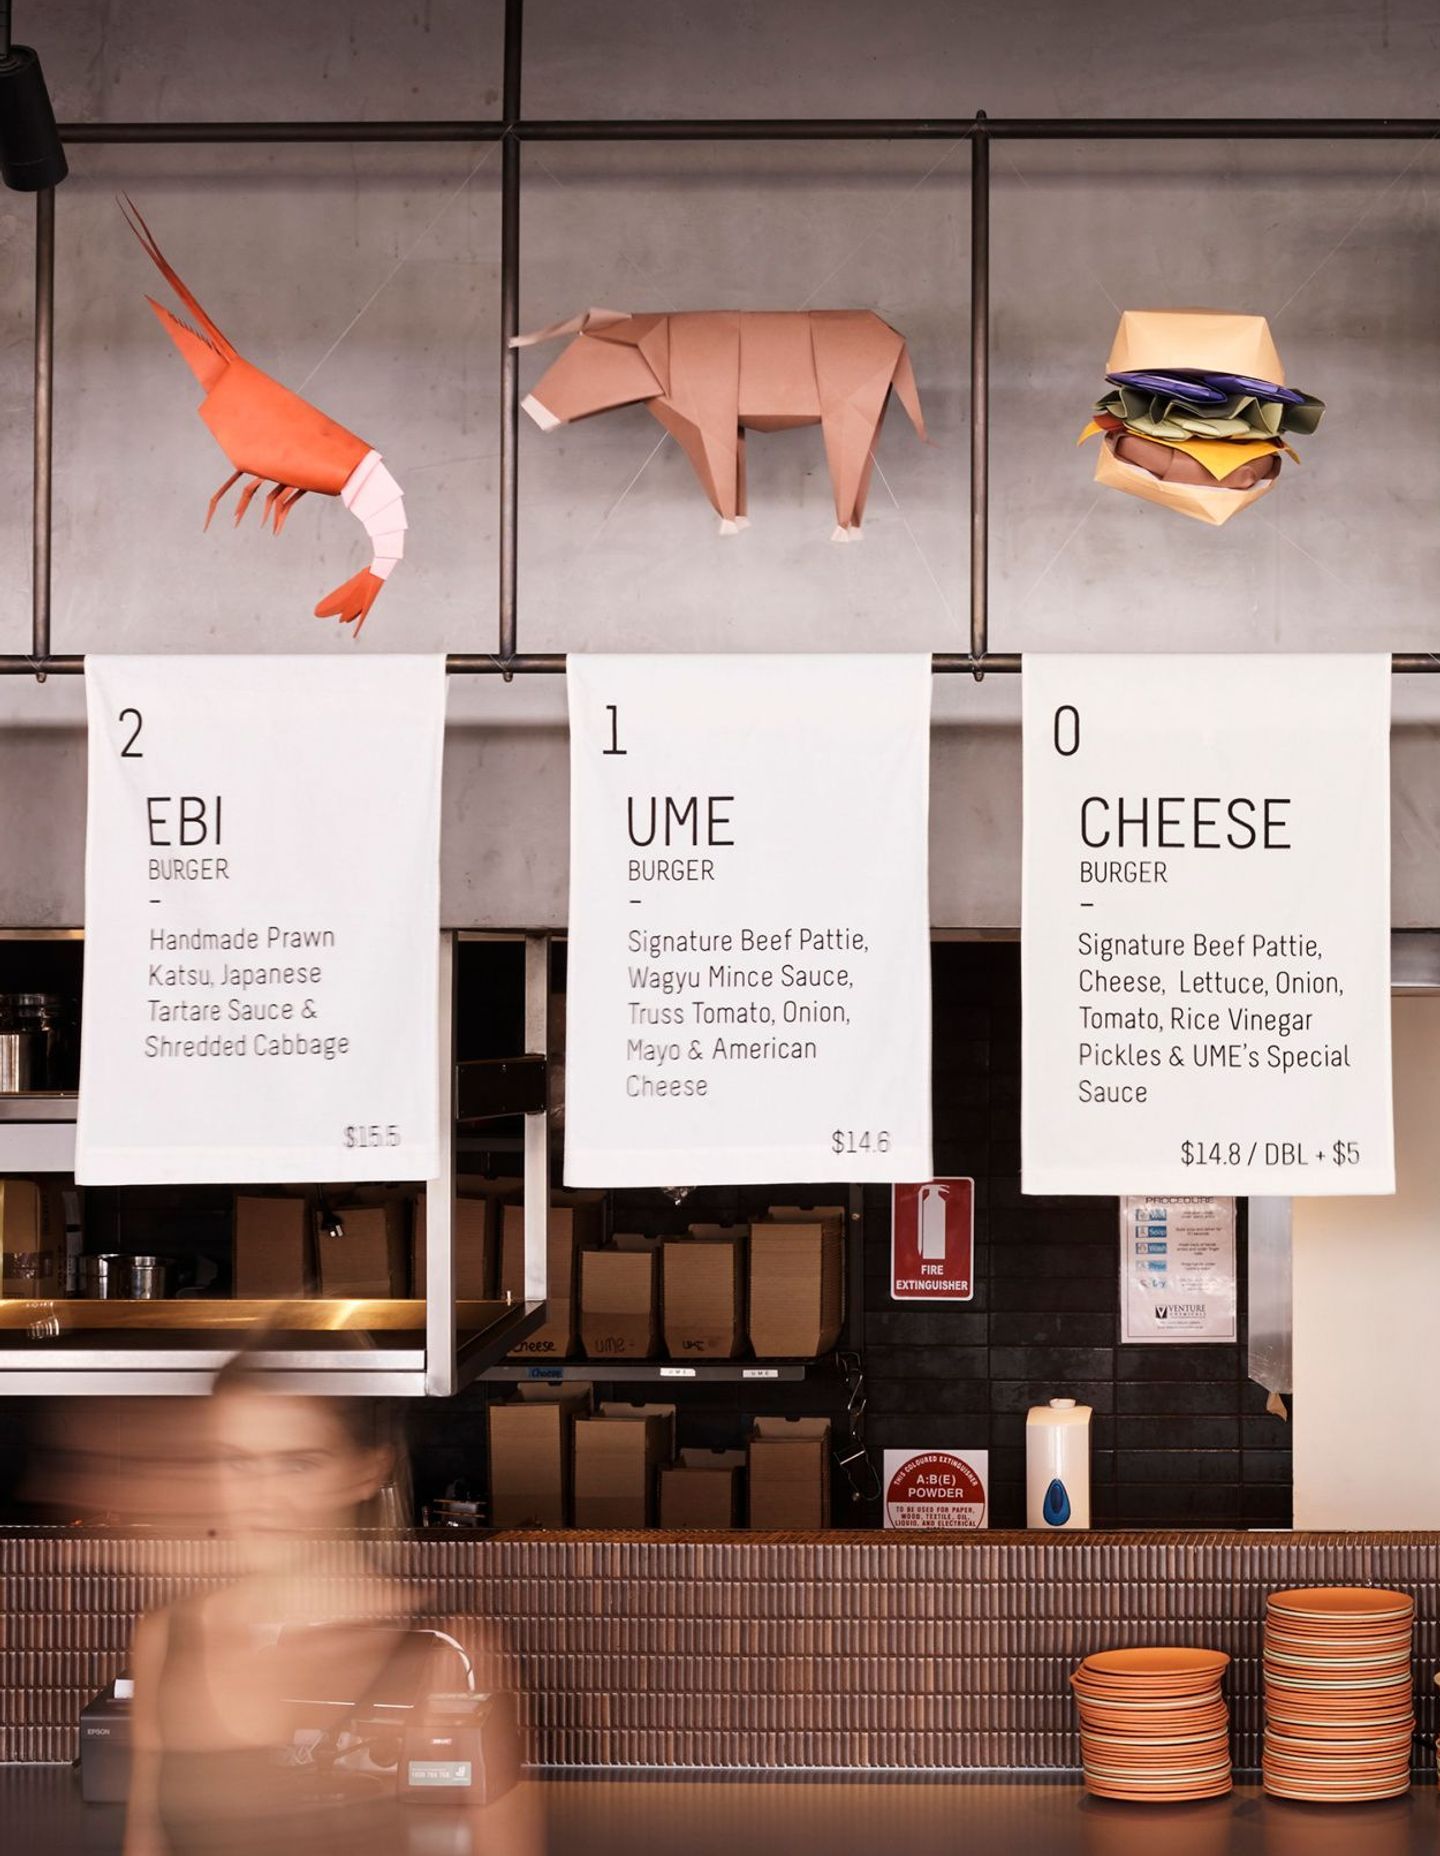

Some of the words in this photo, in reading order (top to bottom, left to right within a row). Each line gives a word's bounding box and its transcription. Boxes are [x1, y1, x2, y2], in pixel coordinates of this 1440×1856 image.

[119, 708, 143, 757] 2
[603, 705, 627, 754] 1
[147, 796, 221, 846] EBI
[628, 796, 734, 846] UME
[1081, 797, 1291, 849] CHEESE
[149, 858, 229, 880] BURGER
[629, 859, 714, 881] BURGER
[1081, 861, 1167, 883] BURGER
[151, 928, 258, 950] Handmade
[268, 927, 334, 948] Prawn
[629, 930, 732, 958] Signature
[742, 928, 792, 951] Beef
[800, 928, 868, 952] Pattie,
[1079, 933, 1184, 962] Signature
[1194, 934, 1245, 956] Beef
[1253, 934, 1321, 959] Pattie,
[149, 965, 214, 987] Katsu,
[221, 964, 321, 990] Japanese
[629, 966, 699, 994] Wagyu
[710, 966, 772, 987] Mince
[781, 964, 853, 988] Sauce,
[1080, 969, 1165, 995] Cheese,
[1181, 970, 1268, 997] Lettuce,
[1277, 971, 1343, 996] Onion,
[148, 1000, 220, 1022] Tartare
[228, 999, 293, 1021] Sauce
[301, 999, 317, 1019] &
[628, 1002, 684, 1024] Truss
[692, 1002, 775, 1025] Tomato,
[784, 1001, 850, 1025] Onion,
[1079, 1006, 1163, 1032] Tomato,
[1172, 1007, 1219, 1030] Rice
[1228, 1008, 1312, 1037] Vinegar
[145, 1035, 246, 1057] Shredded
[254, 1034, 348, 1060] Cabbage
[628, 1039, 680, 1067] Mayo
[688, 1040, 703, 1060] &
[712, 1037, 816, 1059] American
[1080, 1043, 1161, 1066] Pickles
[1169, 1046, 1184, 1066] &
[1268, 1045, 1350, 1074] Special
[627, 1075, 707, 1097] Cheese
[1079, 1080, 1147, 1103] Sauce
[832, 1129, 889, 1155] $14.6
[1181, 1140, 1240, 1167] $14.8
[1266, 1143, 1308, 1165] DBL
[1333, 1140, 1359, 1166] $5
[921, 1265, 943, 1274] FIRE
[896, 1280, 967, 1290] EXTINGUISHER
[894, 1472, 906, 1485] THIS
[905, 1456, 937, 1472] COLOURED
[939, 1456, 978, 1486] EXTINGUISHER
[916, 1474, 956, 1486] A:B(E)
[908, 1488, 963, 1498] POWDER
